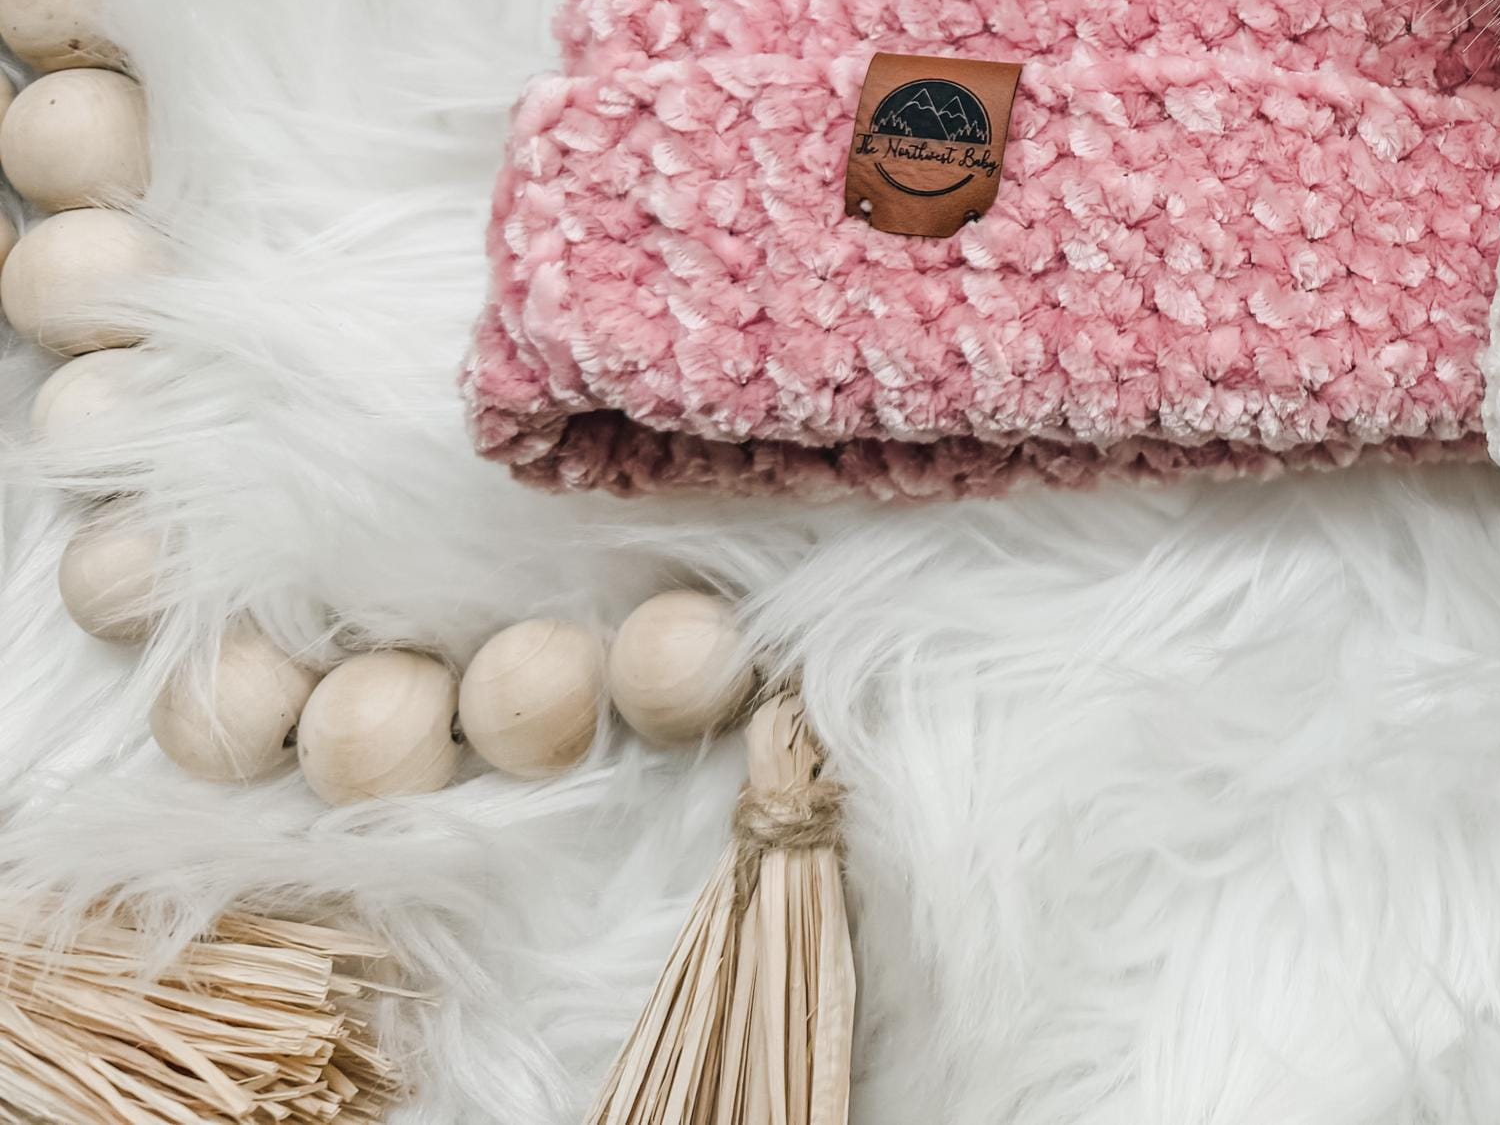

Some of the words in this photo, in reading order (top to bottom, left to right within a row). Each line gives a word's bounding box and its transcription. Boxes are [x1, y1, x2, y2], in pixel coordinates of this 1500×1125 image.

[856, 133, 878, 155] The
[883, 138, 955, 165] Northwest
[958, 147, 1000, 178] Baby
